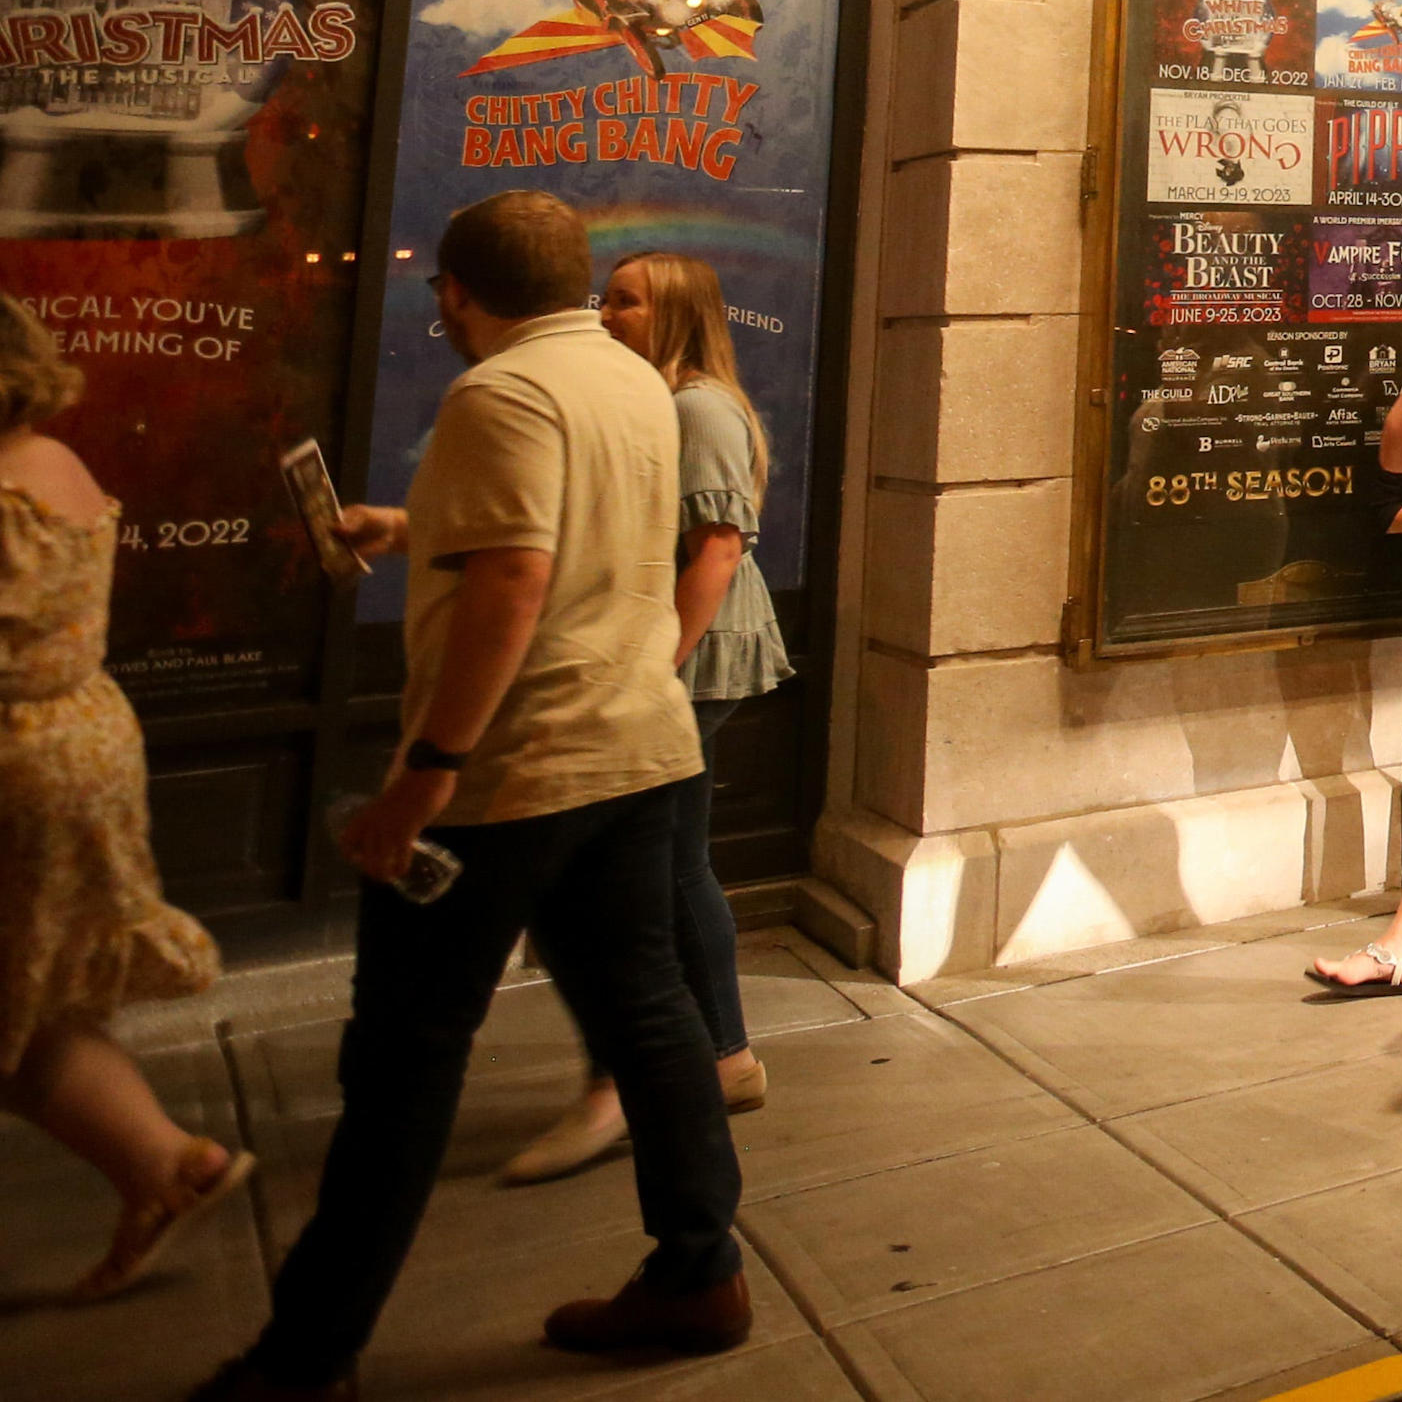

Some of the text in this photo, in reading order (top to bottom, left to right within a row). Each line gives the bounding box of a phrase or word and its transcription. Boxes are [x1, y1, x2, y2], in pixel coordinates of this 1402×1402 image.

[0, 0, 356, 68] RISTMAS
[1182, 16, 1289, 42] CHRISTMAS
[1159, 64, 1309, 86] NOV. 18 2022
[1348, 59, 1381, 74] BANG
[38, 68, 258, 86] THE MUSICAL
[465, 72, 761, 126] CHITTY CHITTY
[1343, 99, 1356, 108] THE
[1155, 114, 1308, 134] THE PLAY THAT GOES
[461, 116, 743, 181] BANG BANG
[1158, 129, 1301, 171] WRONG
[1168, 186, 1216, 201] MARCH
[1253, 188, 1292, 203] 2023
[1328, 191, 1364, 206] APRIL
[1179, 212, 1205, 221] MERCY
[1319, 216, 1348, 225] WORLD
[1172, 222, 1286, 255] BEAUTY
[1212, 256, 1268, 266] AND THE
[1313, 241, 1382, 269] VAMPIRE
[1185, 256, 1274, 289] BEAST
[1171, 292, 1190, 301] THE
[1312, 293, 1344, 309] OCT.
[1347, 293, 1363, 308] 28
[22, 295, 256, 331] SICAL YOU'VE
[1170, 308, 1202, 325] JUNE
[1243, 307, 1282, 323] 2023
[52, 329, 242, 362] EAMING OF
[1267, 331, 1348, 341] SEASON SPONSORED BY
[1369, 359, 1397, 368] BRYAN
[1141, 388, 1193, 399] THE GUILD
[1226, 466, 1354, 502] SEASON
[158, 518, 250, 549] 2022
[153, 659, 185, 671] AND
[223, 651, 264, 665] BLAKE
